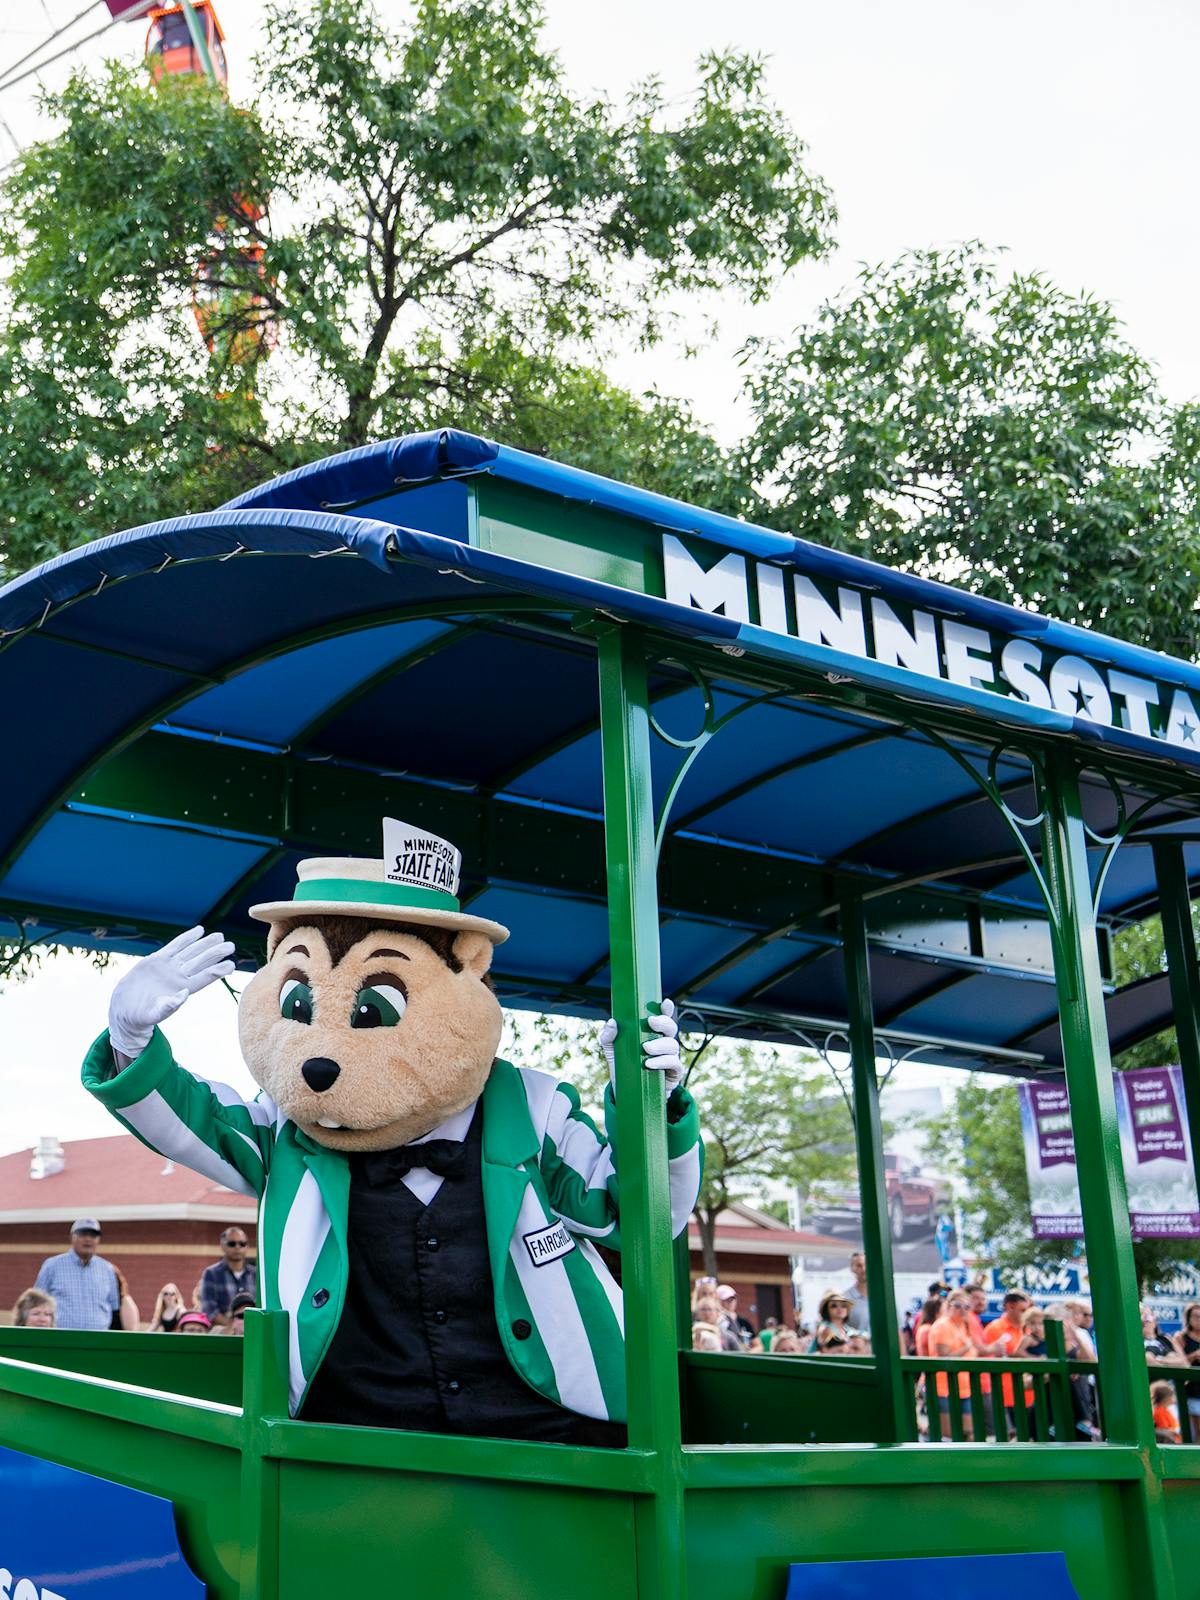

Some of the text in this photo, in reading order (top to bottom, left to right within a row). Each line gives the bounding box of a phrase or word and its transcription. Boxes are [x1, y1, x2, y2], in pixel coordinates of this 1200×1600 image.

[662, 533, 1200, 752] MINNESOTA
[404, 838, 454, 867] MINNESOTA
[393, 852, 455, 890] STATE FAIR
[1138, 1105, 1169, 1124] FUN
[529, 1226, 571, 1258] FAIRCHIL
